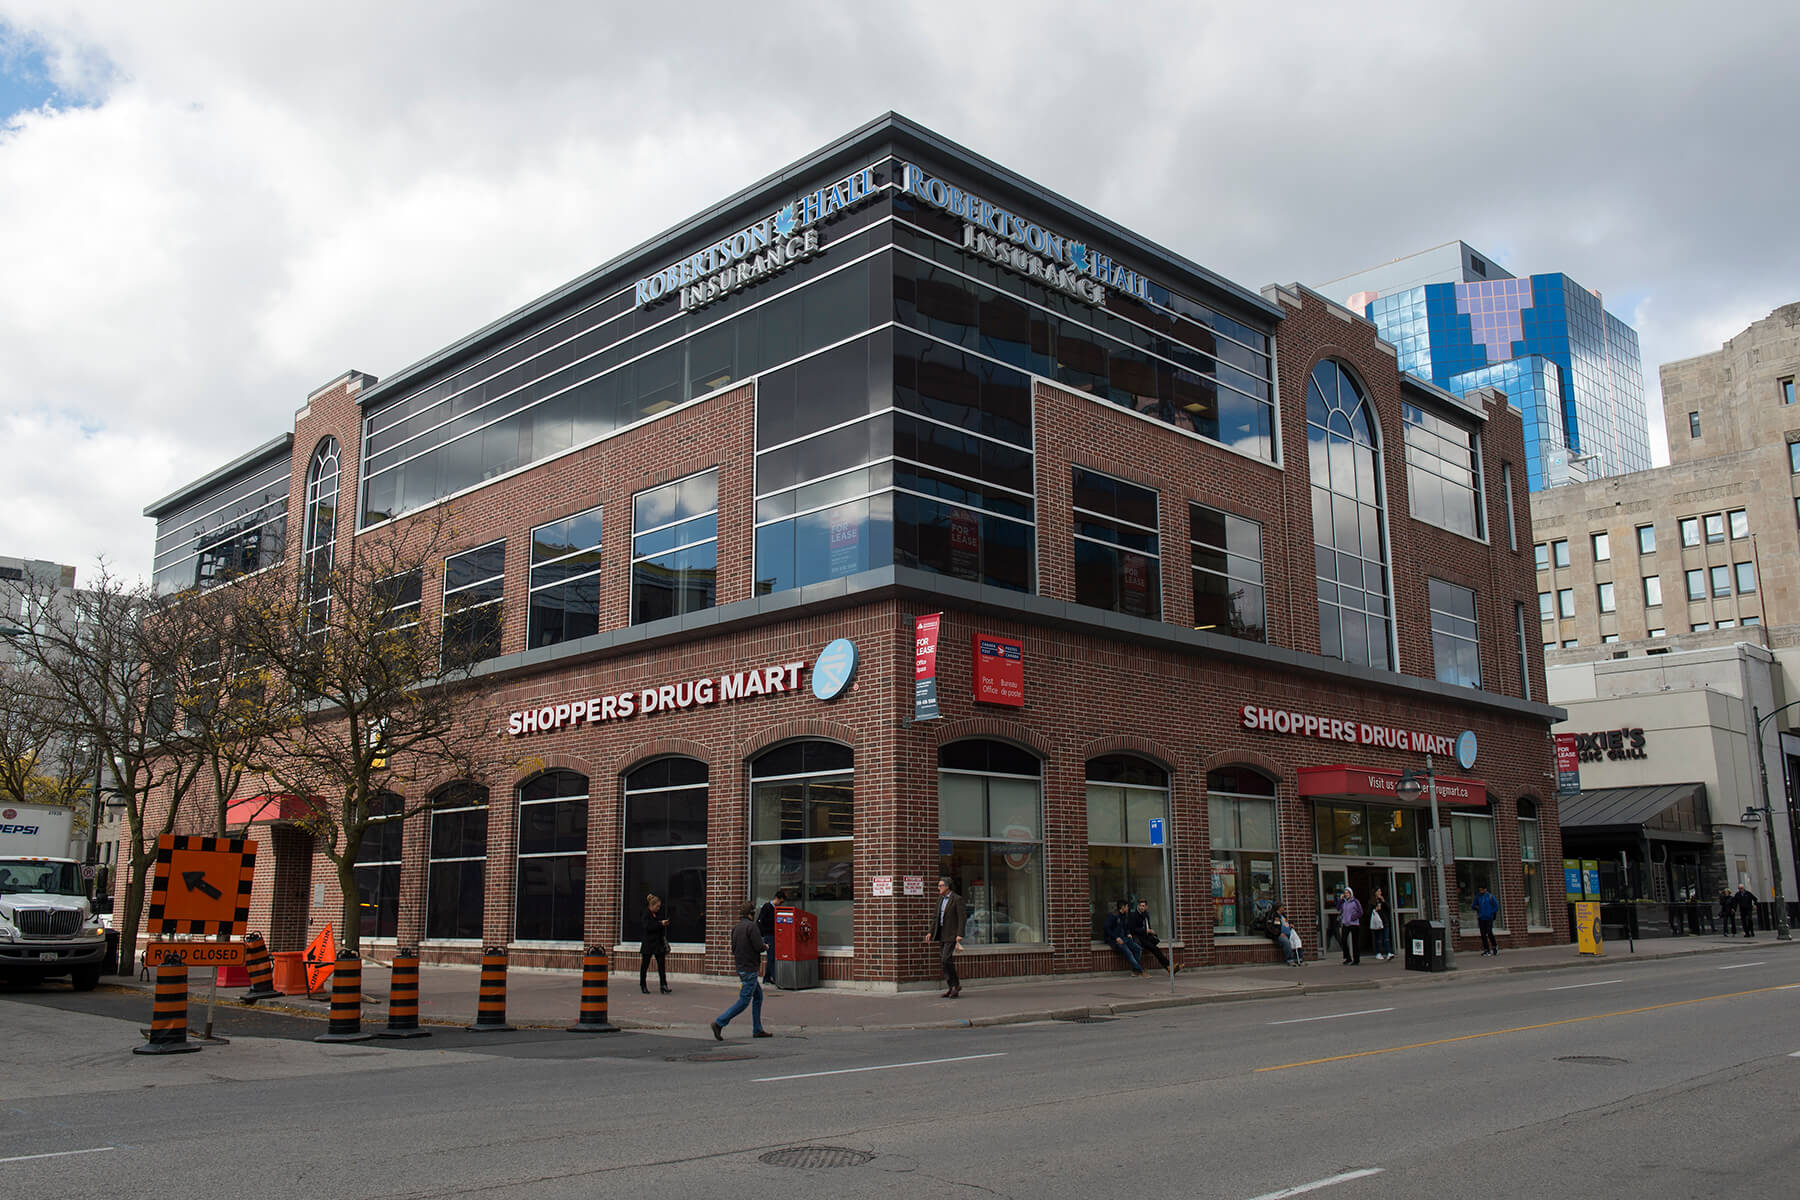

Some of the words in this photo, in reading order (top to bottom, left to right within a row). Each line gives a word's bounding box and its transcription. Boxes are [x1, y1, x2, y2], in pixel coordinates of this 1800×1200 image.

[634, 218, 771, 308] ROBERTSON
[801, 167, 879, 228] HALL
[901, 162, 1065, 263] ROBERTSON
[1086, 250, 1153, 303] HALL
[679, 229, 819, 311] INSURANCE
[963, 224, 1106, 306] INSURANCE
[831, 520, 849, 534] FOR
[951, 523, 969, 535] FOR
[831, 528, 857, 543] LEASE
[951, 533, 977, 547] LEASE
[916, 637, 929, 647] FOR
[916, 645, 935, 656] LEASE
[982, 676, 994, 685] Post
[982, 685, 999, 695] Office
[507, 692, 638, 735] SHOPPERS
[641, 678, 718, 713] DRUG
[720, 662, 808, 701] MART
[1241, 706, 1356, 743] SHOPPERS
[1359, 723, 1409, 750] DRUG
[1410, 732, 1455, 756] MART
[1575, 728, 1645, 752] OXIE'S
[1607, 748, 1648, 761] GRILL
[1368, 776, 1384, 789] Visit
[1386, 781, 1394, 790] us
[192, 949, 238, 960] CLOSED
